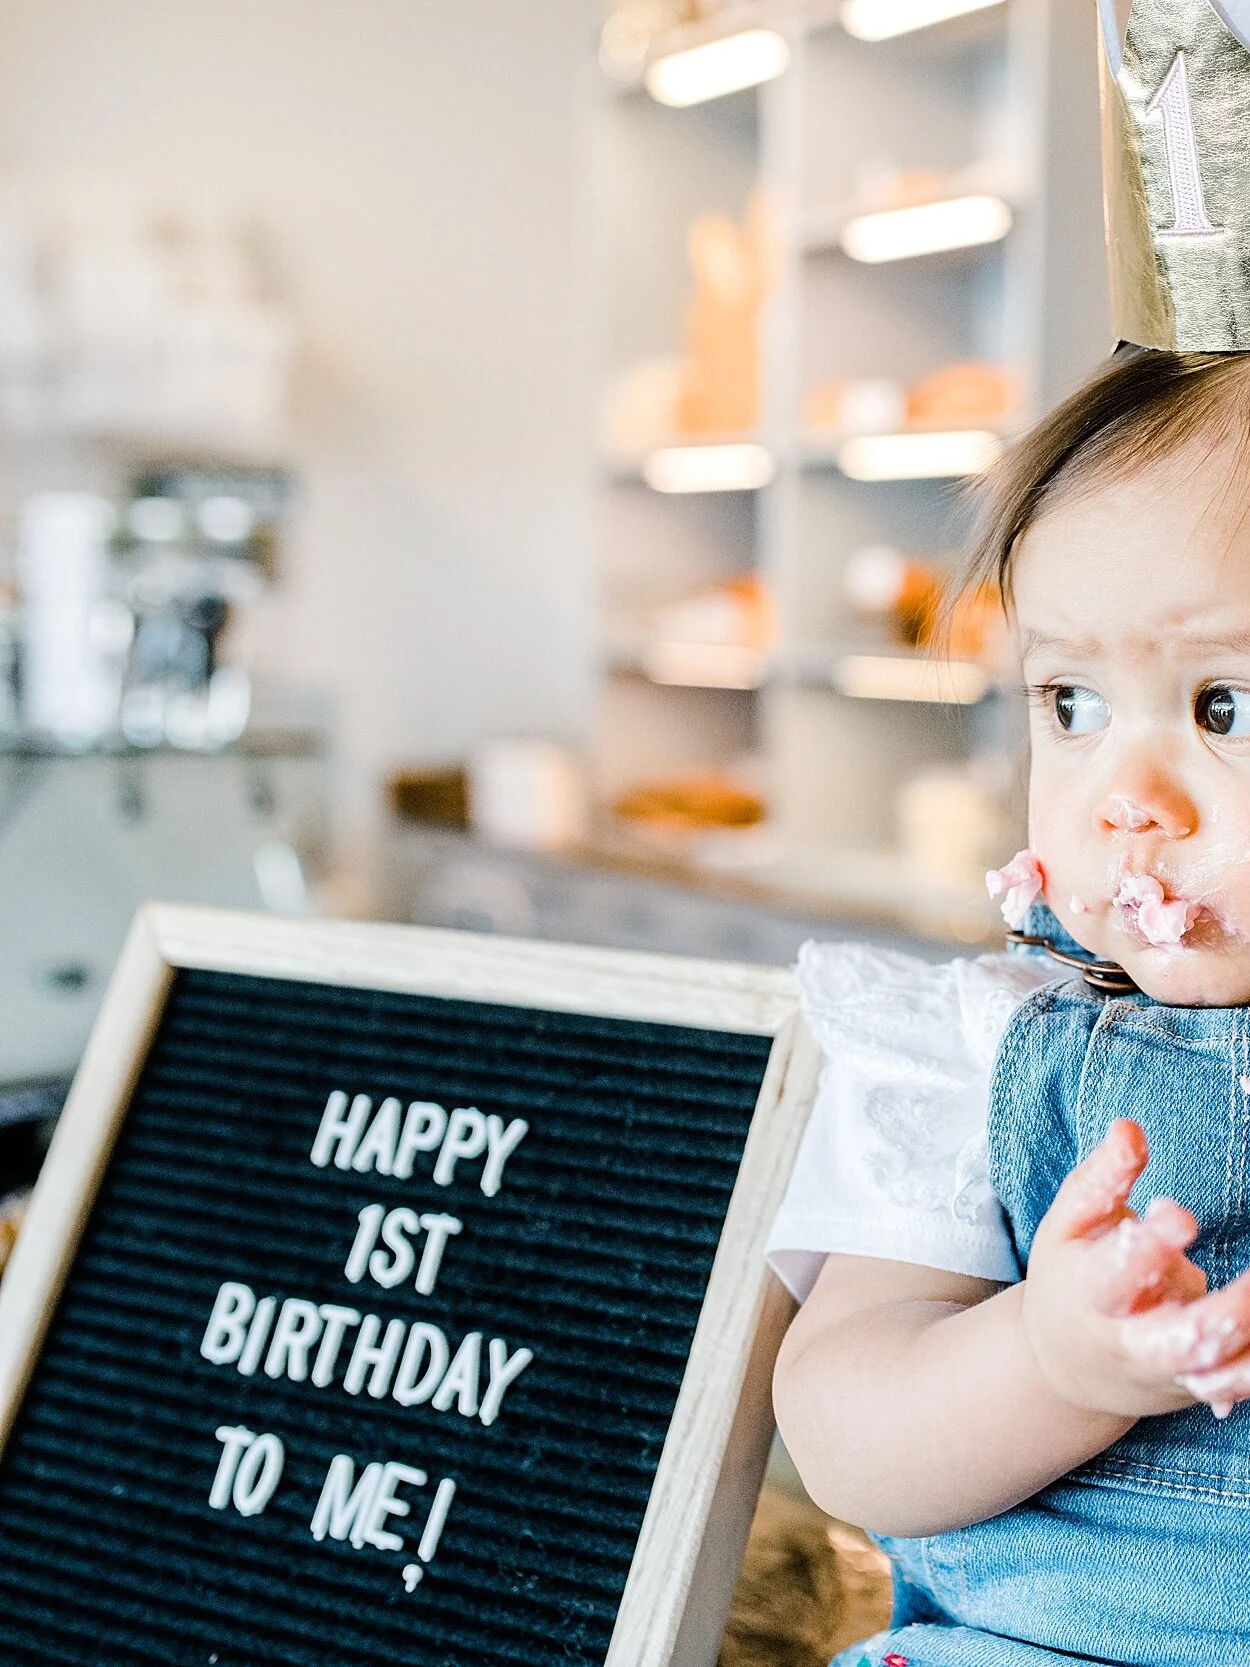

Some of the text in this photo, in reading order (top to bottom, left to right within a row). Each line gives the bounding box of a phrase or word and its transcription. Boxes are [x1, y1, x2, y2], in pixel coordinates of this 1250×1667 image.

[1146, 50, 1225, 239] 1
[310, 1090, 529, 1197] HAPPY
[344, 1203, 463, 1295] 1ST
[200, 1281, 534, 1426] BIRTHDAY
[208, 1425, 457, 1593] TO ME!
